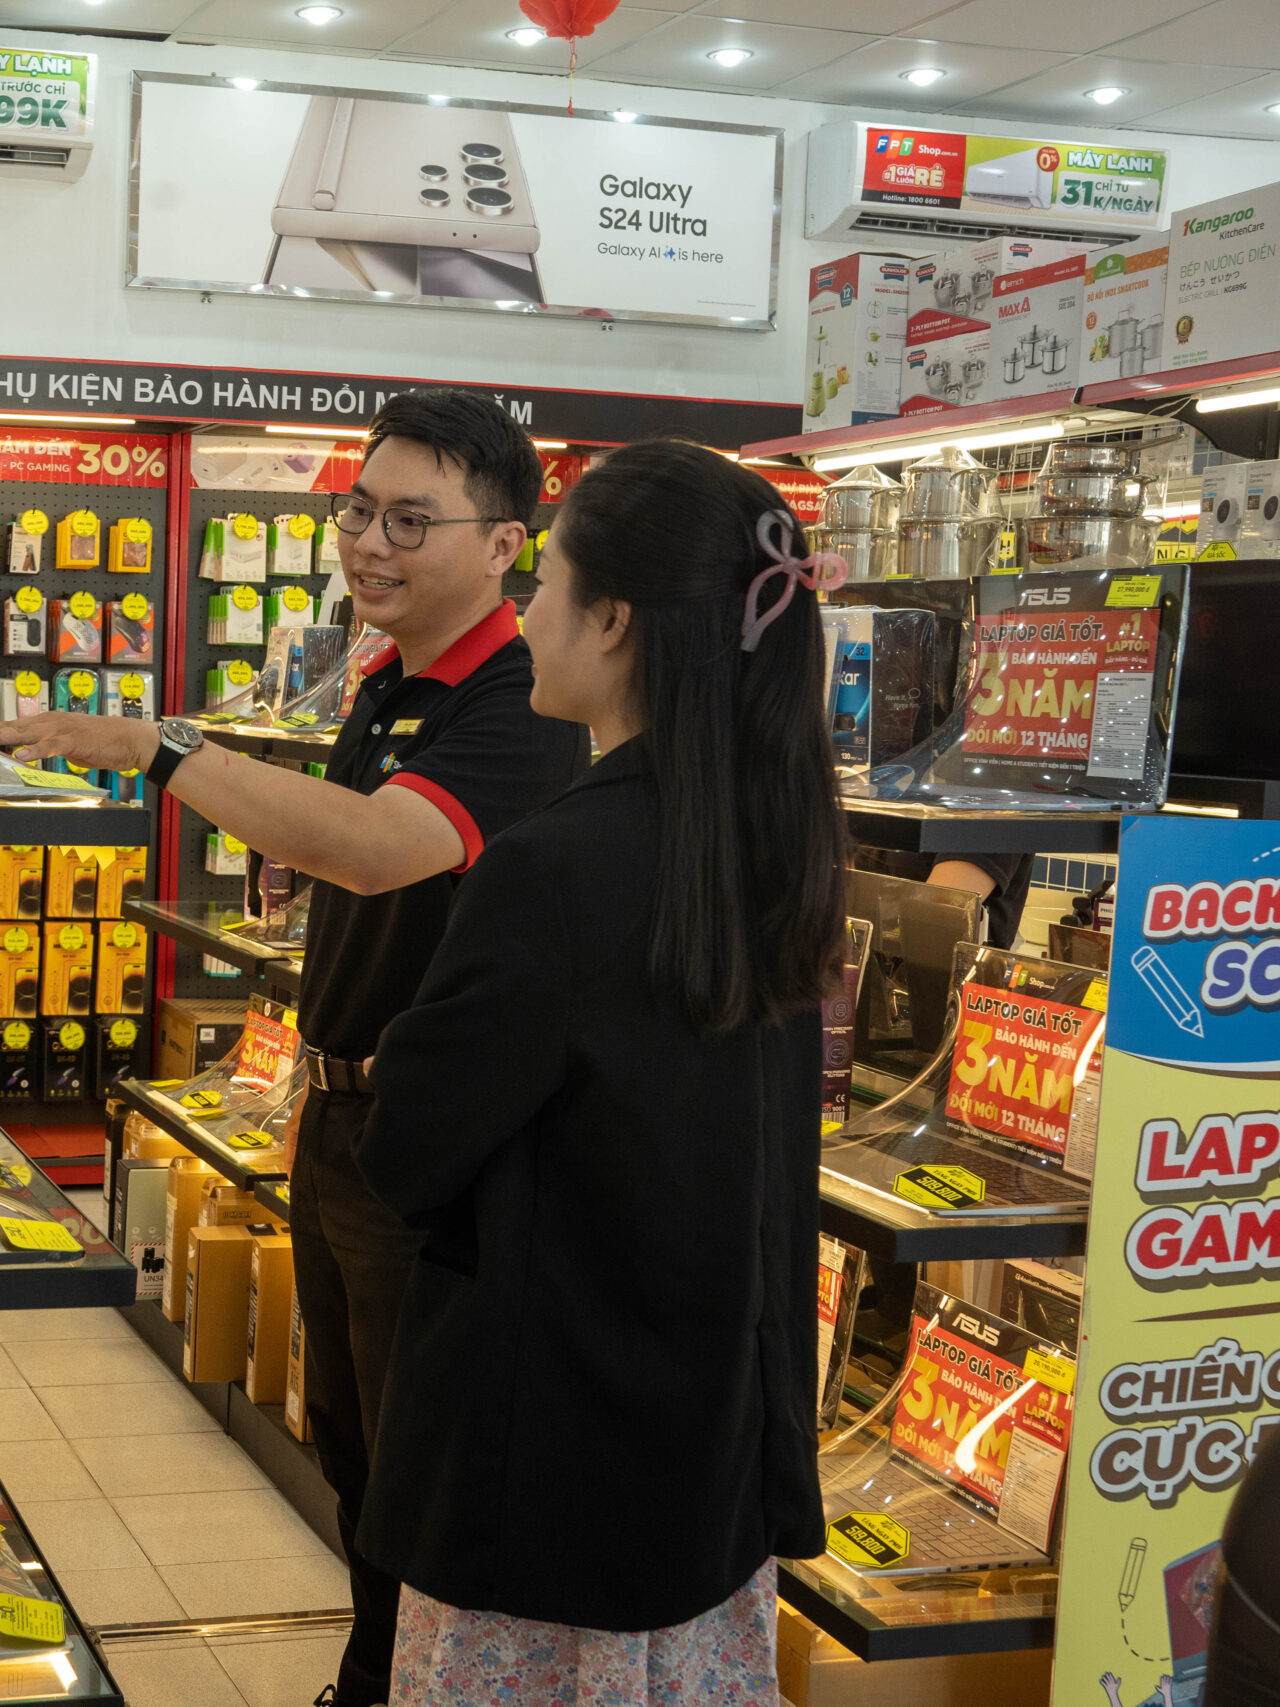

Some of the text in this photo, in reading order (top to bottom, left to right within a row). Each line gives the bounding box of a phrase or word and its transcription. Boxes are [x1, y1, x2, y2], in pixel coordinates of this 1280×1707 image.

[14, 54, 72, 76] LẠNH
[876, 136, 913, 156] FPT
[1067, 151, 1153, 175] MÁY LẠNH
[599, 174, 693, 209] Galaxy
[882, 193, 906, 203] Hotline:
[907, 196, 924, 205] 1800
[1060, 178, 1094, 207] 31
[598, 206, 708, 237] S24 Ultra
[1219, 222, 1265, 241] KitchenCare
[597, 242, 724, 264] Galaxy AI is here
[48, 372, 123, 407] KIỆN
[134, 373, 204, 406] BẢO
[213, 377, 302, 411] HÀNH
[310, 382, 365, 416] ĐỔI
[10, 461, 25, 472] PC
[26, 462, 70, 474] GAMING
[77, 442, 165, 478] 30%
[1018, 587, 1071, 607] ASUS
[980, 615, 1104, 643] LAPTOP GIÁ TỐT
[855, 647, 865, 656] 32
[1011, 648, 1035, 666] BẢO
[1037, 648, 1071, 666] HÀNH
[1071, 646, 1098, 665] ĐẾN
[1106, 639, 1150, 653] LAPTOP
[972, 651, 1006, 717] 3
[1006, 667, 1095, 721] NĂM
[966, 721, 990, 745] ĐỔI
[1020, 730, 1034, 743] 12
[1037, 727, 1089, 749] THÁNG
[966, 993, 1083, 1038] LAPTOP GIÁ TỐT
[994, 1026, 1077, 1061] BẢO HÀNH ĐẾN
[954, 1019, 1074, 1115] 3 NĂM
[949, 1087, 972, 1114] ĐỔI
[973, 1098, 999, 1122] MỚI
[1000, 1109, 1015, 1127] 12
[1017, 1110, 1067, 1144] THÁNG
[951, 1312, 1001, 1347] ASUS
[915, 1327, 1024, 1393] LAPTOP GIÁ TỐT
[1109, 1344, 1259, 1403] CHIẾN
[901, 1353, 940, 1422] 3
[940, 1367, 993, 1406] BẢO HÀNH
[1024, 1403, 1066, 1431] LAPTOP
[895, 1419, 942, 1462] ĐỔI MỚI
[1094, 1419, 1244, 1488] CỰC
